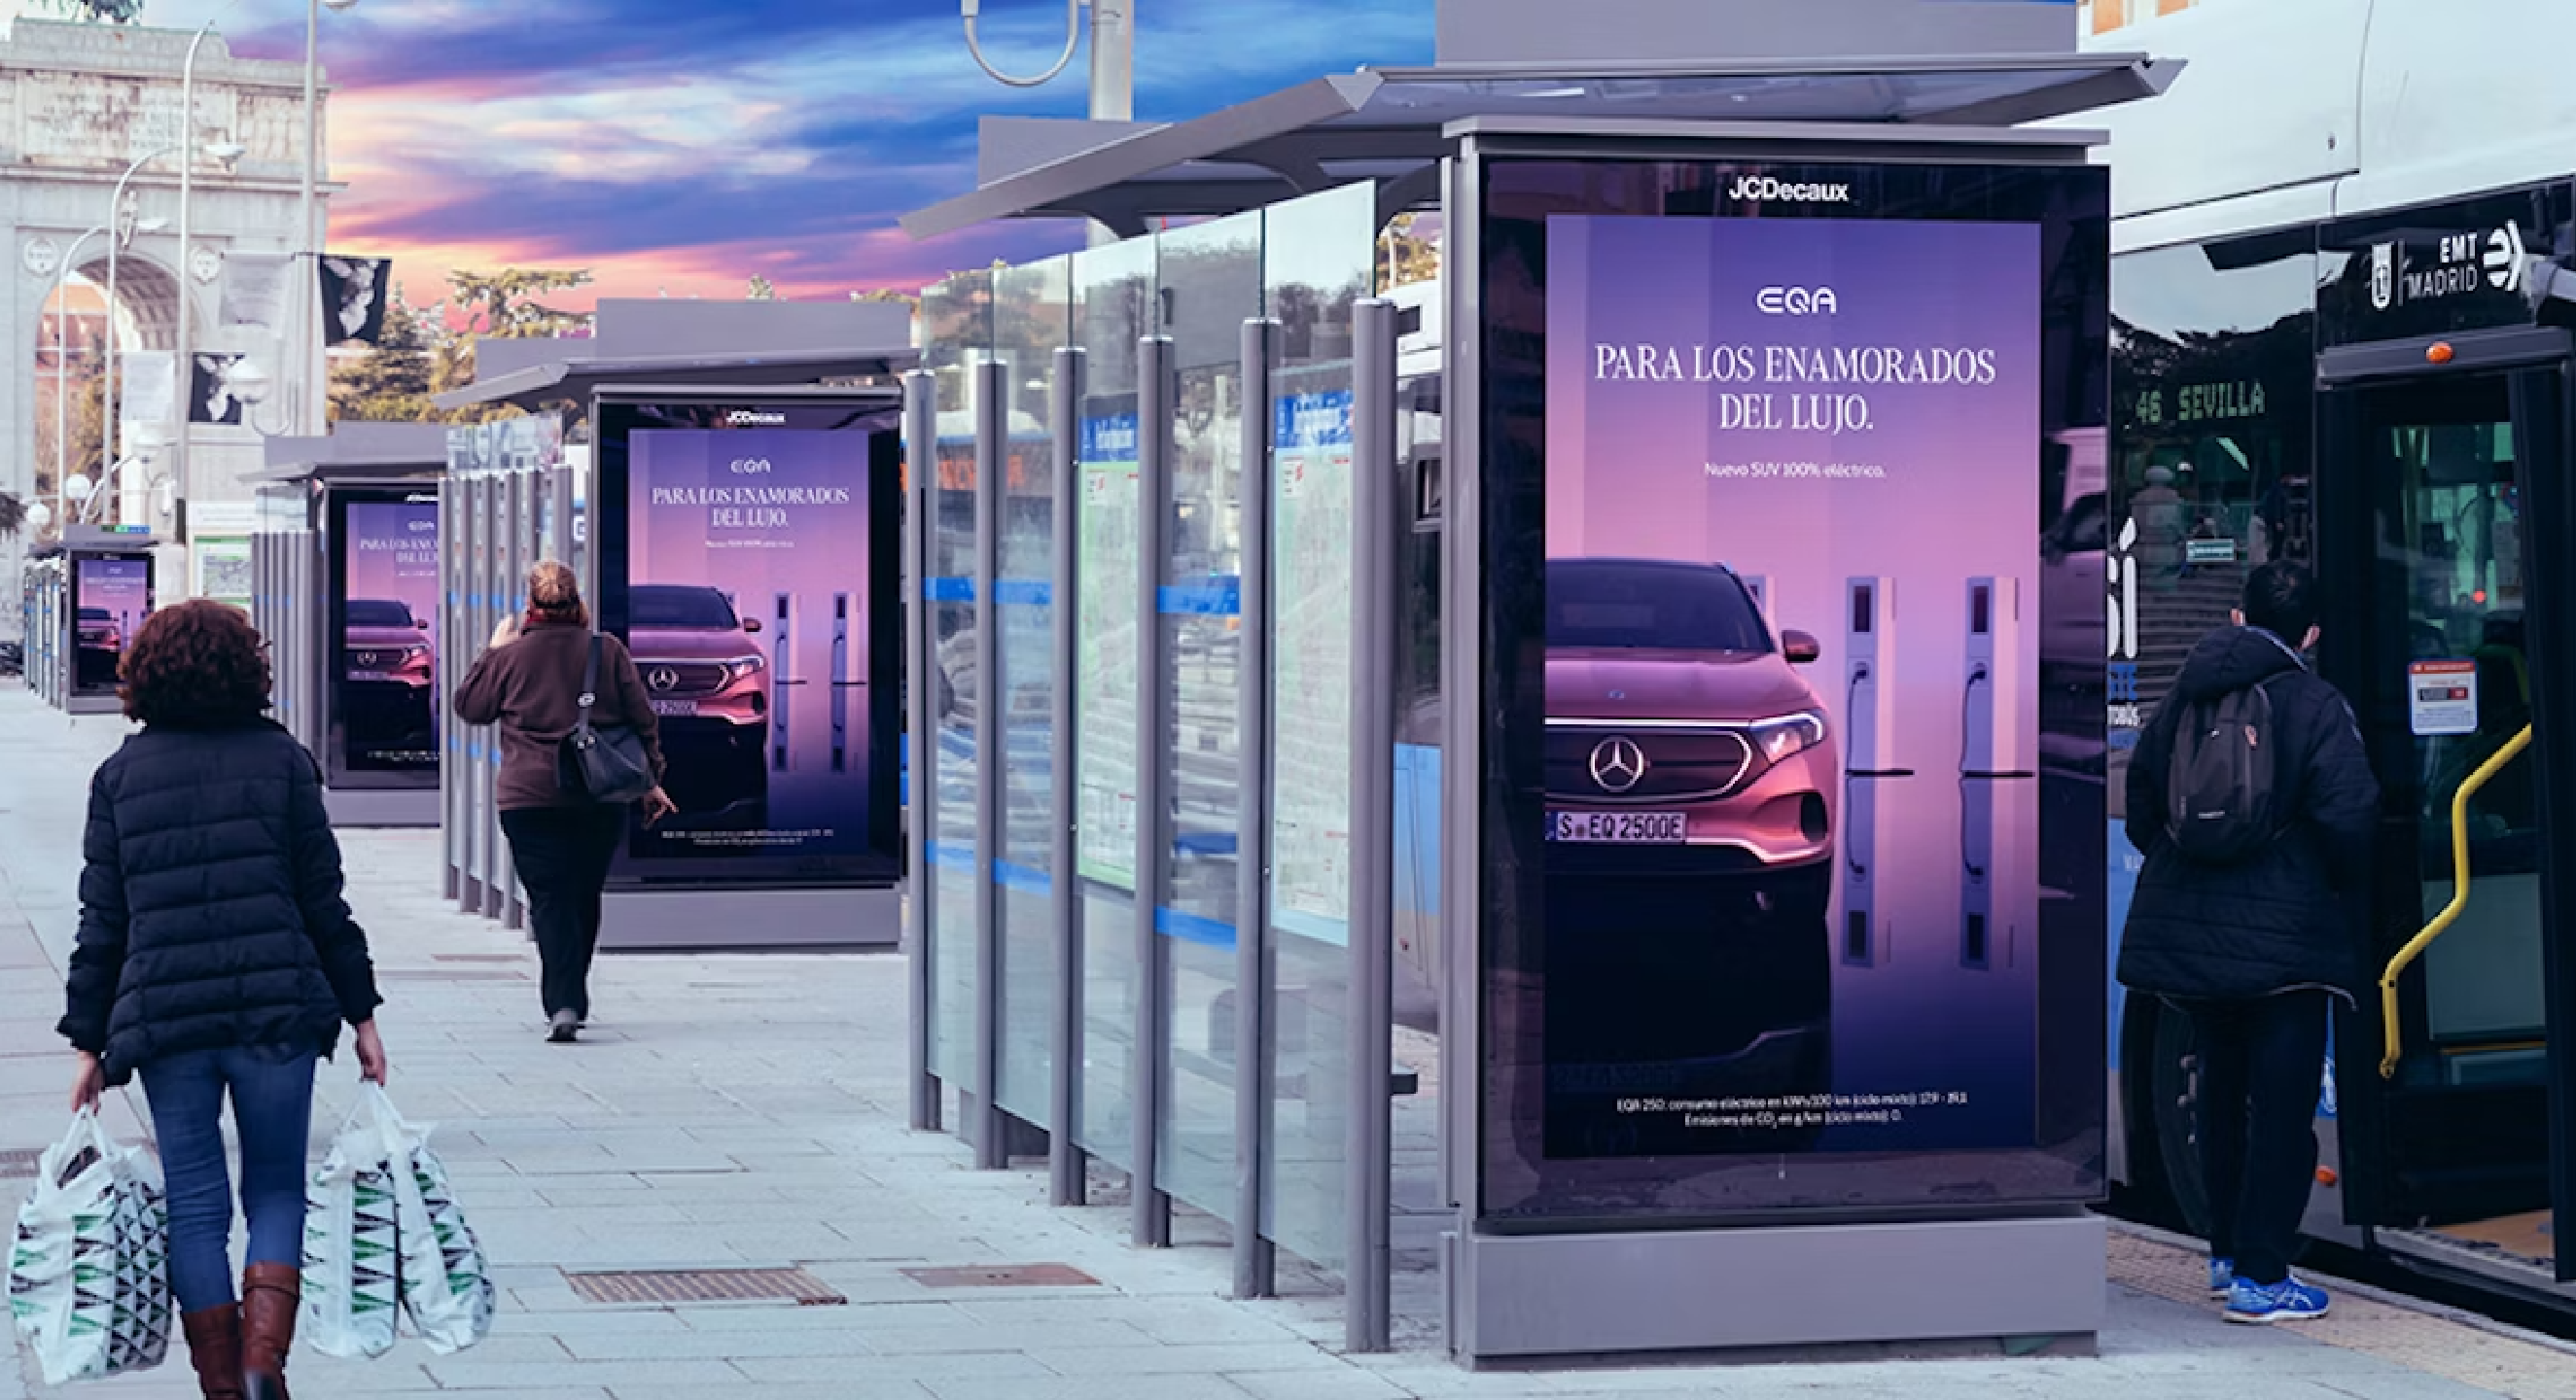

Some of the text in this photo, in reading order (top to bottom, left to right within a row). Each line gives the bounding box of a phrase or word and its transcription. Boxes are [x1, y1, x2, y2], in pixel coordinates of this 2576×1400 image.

[1729, 177, 1848, 202] JCDecaux
[2440, 232, 2478, 263] EMT
[2407, 264, 2478, 300] MADRID
[1756, 287, 1836, 314] EQA
[1596, 345, 1996, 385] PARA LOS ENAMORADOS
[2178, 380, 2266, 421] SEVILLA
[1719, 394, 1875, 436] DEL LUJO.
[1704, 463, 1749, 478] Nuevo
[1750, 462, 1780, 478] SUV
[1782, 462, 1821, 478] 100%
[652, 486, 850, 505] PARA LOS ENAMORADOS
[713, 507, 744, 527] DEL
[1562, 815, 1572, 839] S
